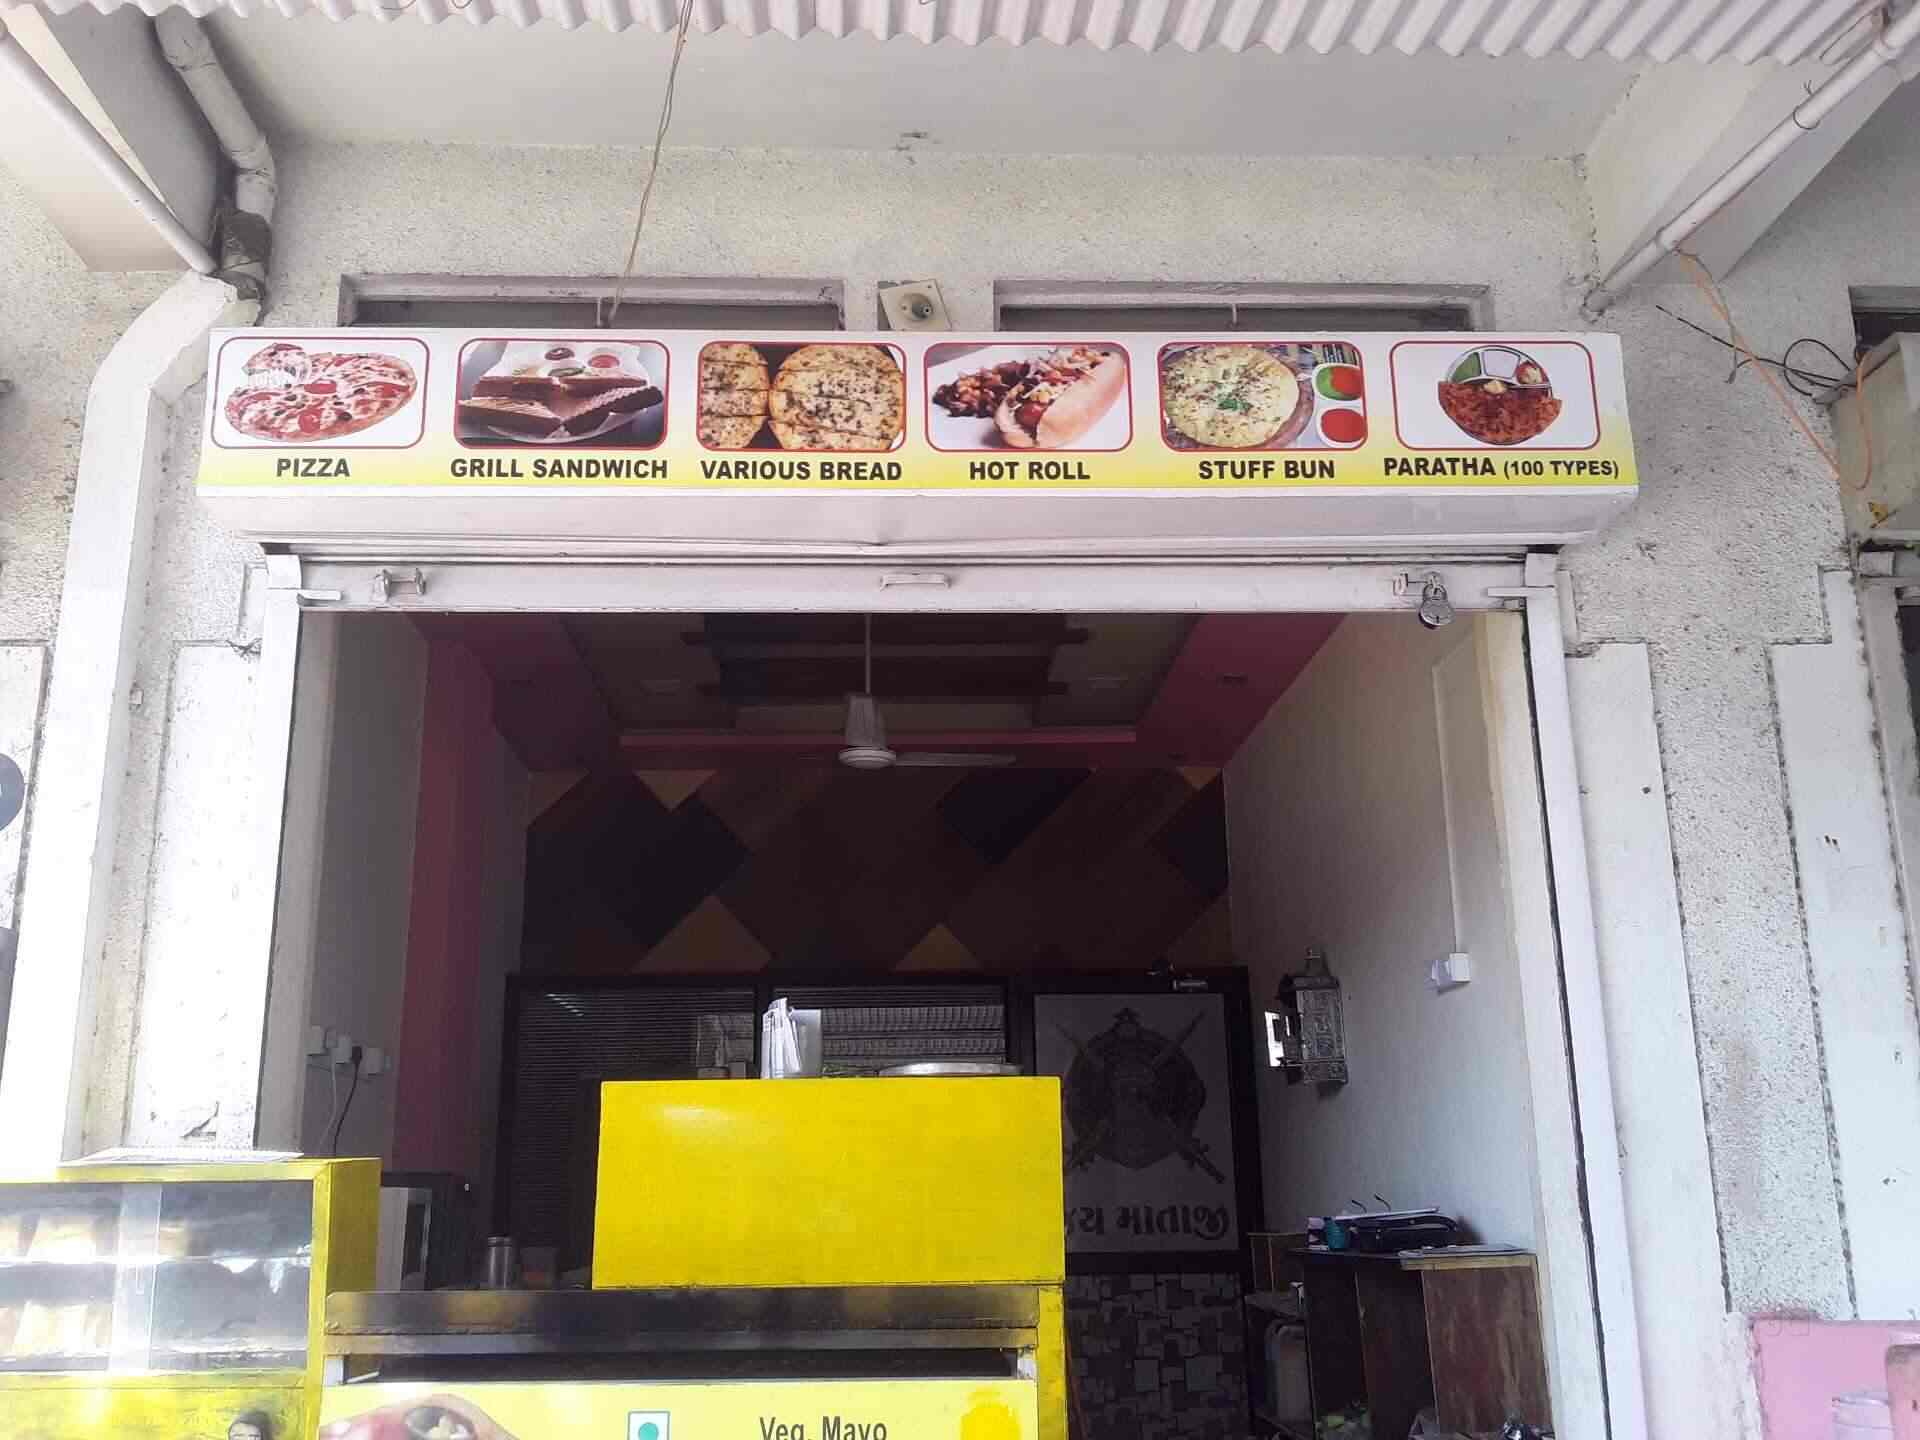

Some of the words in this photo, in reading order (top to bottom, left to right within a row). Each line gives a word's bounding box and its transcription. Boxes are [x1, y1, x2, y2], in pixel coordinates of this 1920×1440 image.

[277, 458, 350, 477] PIZZA
[451, 458, 523, 478] GRILL
[533, 459, 667, 478] SANDWICH
[701, 460, 810, 480] VARIOUS
[820, 461, 902, 481] BREAD
[970, 461, 1019, 480] HOT
[1028, 461, 1090, 480] ROLL
[1199, 460, 1275, 480] STUFF
[1284, 460, 1335, 479] BUN
[1383, 457, 1497, 476] PARATHA
[1503, 459, 1544, 480] (100
[1549, 459, 1619, 480] TYPES)
[822, 1415, 887, 1440] Mayo
